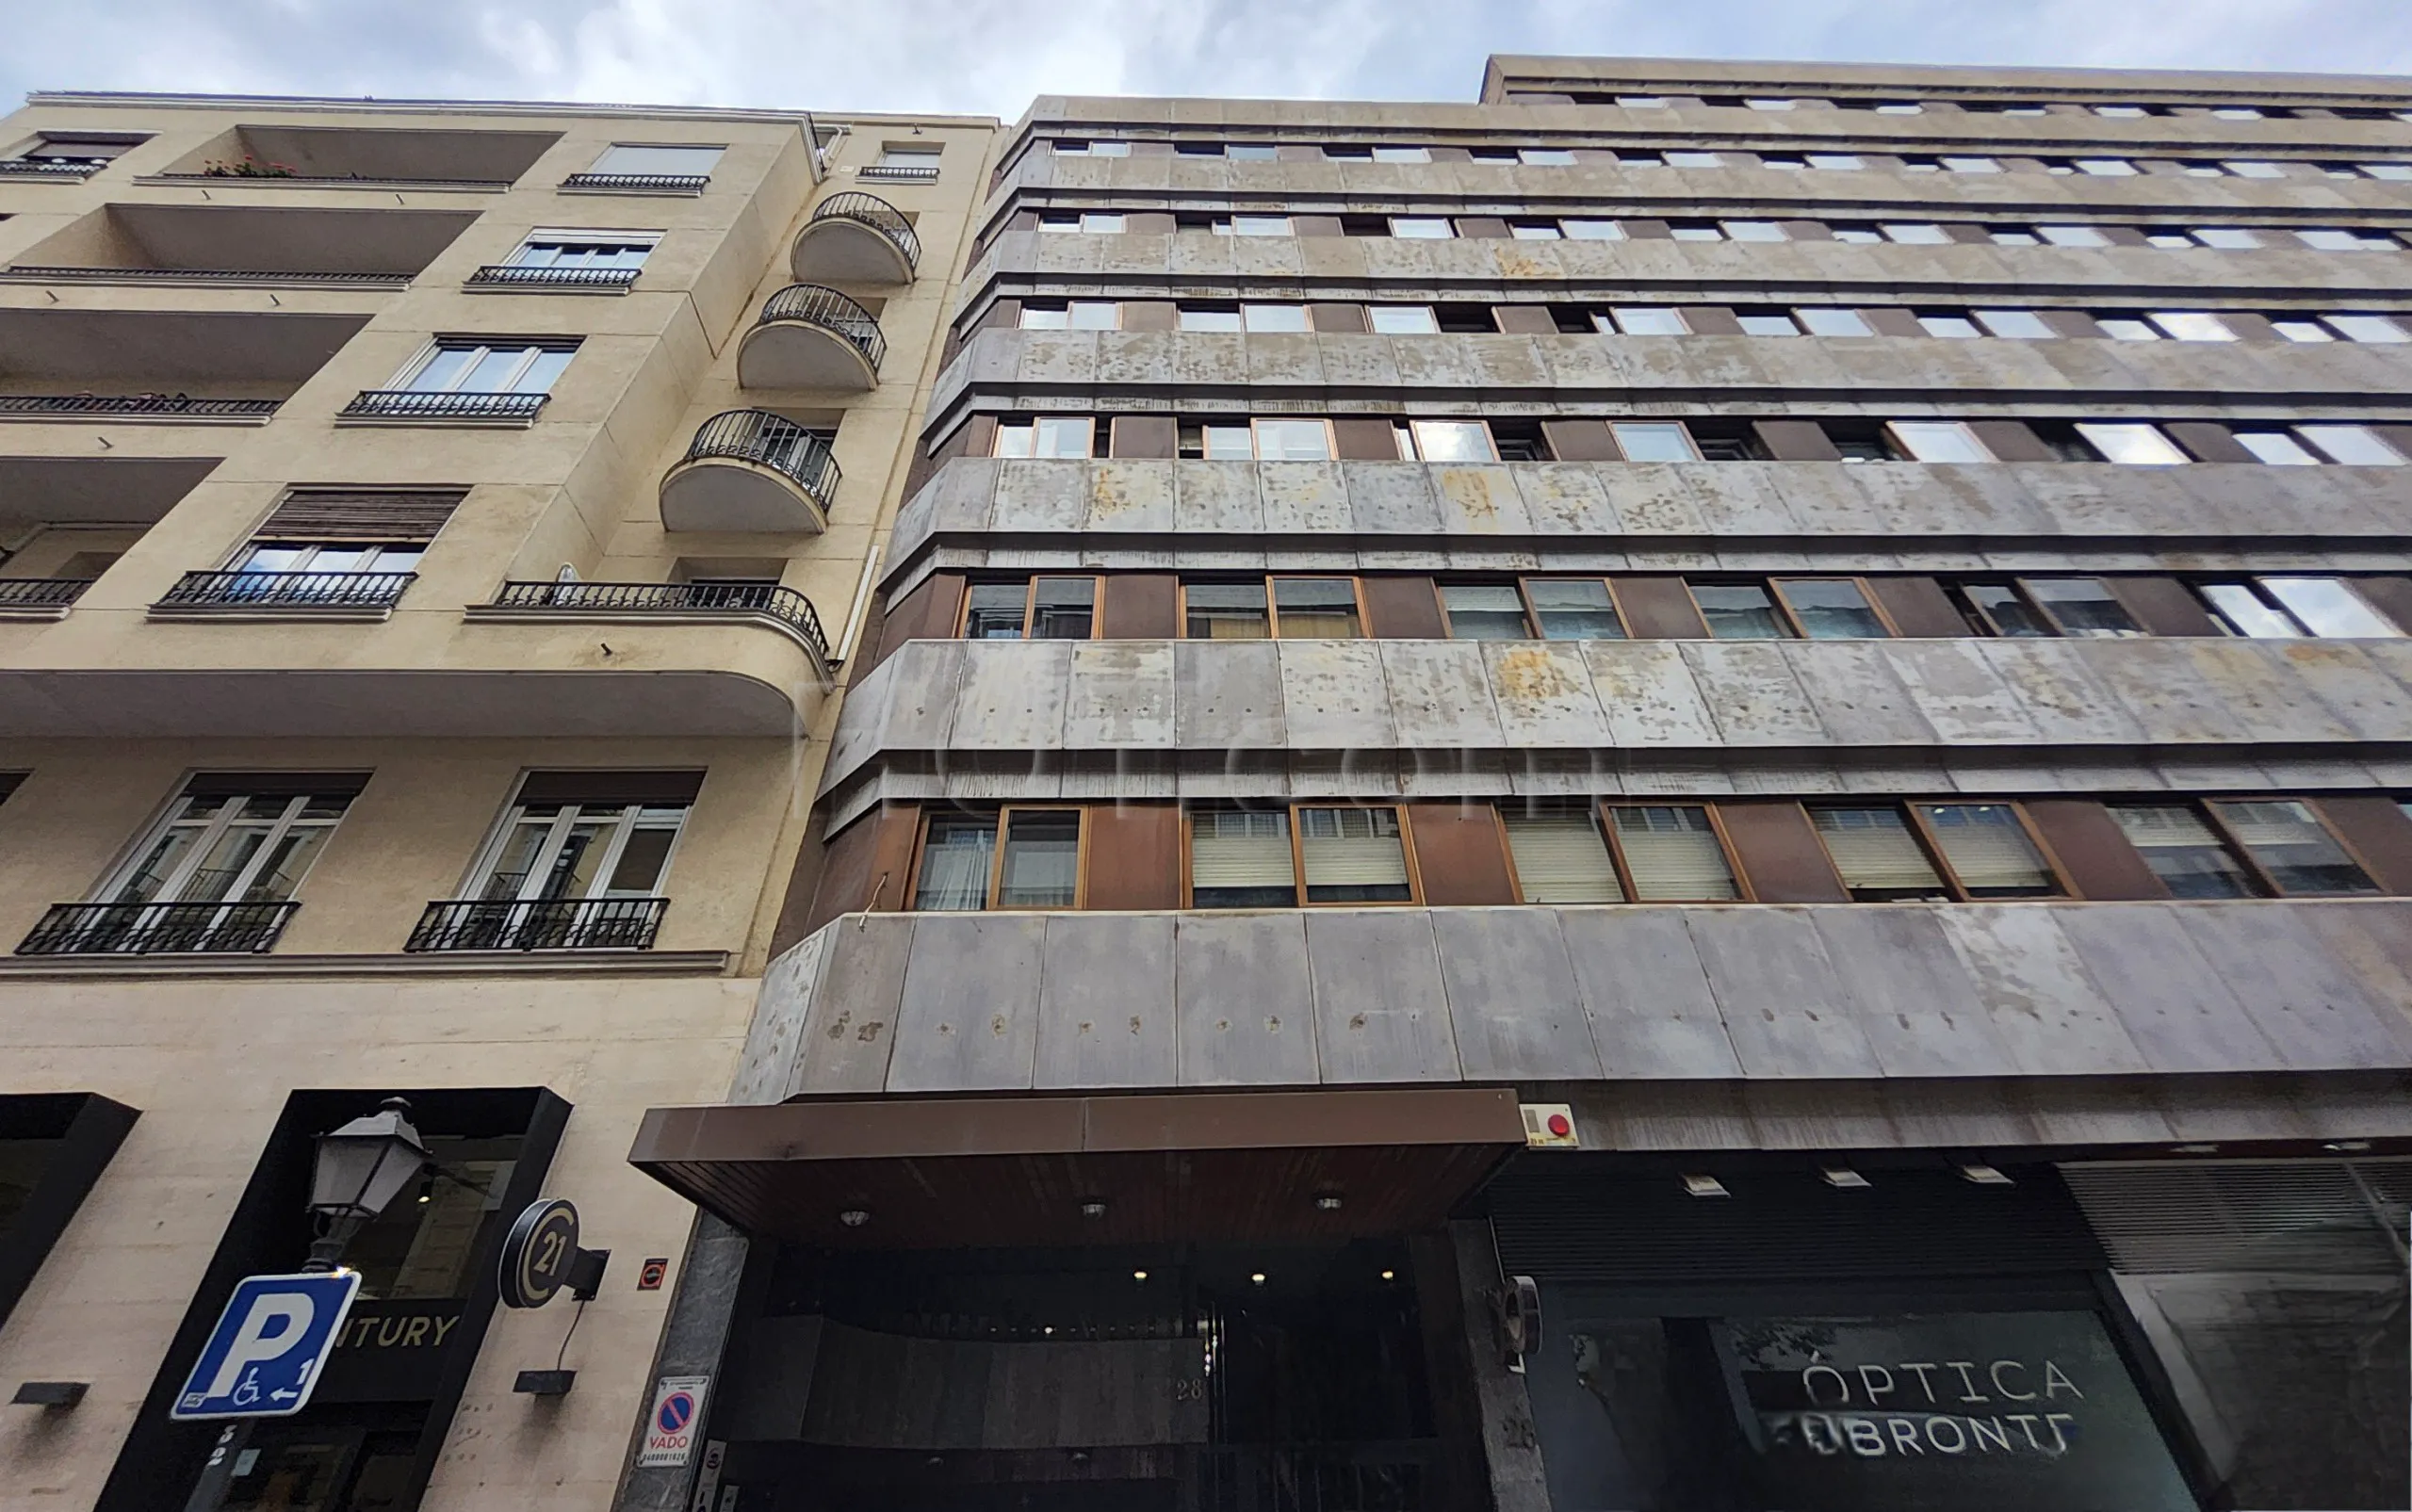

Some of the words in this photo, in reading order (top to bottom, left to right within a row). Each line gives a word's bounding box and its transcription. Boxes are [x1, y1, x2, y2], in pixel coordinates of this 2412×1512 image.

[533, 1231, 567, 1276] 21
[205, 1293, 315, 1398] P
[1802, 1350, 2084, 1406] ÓPTICA
[650, 1435, 688, 1450] VADO
